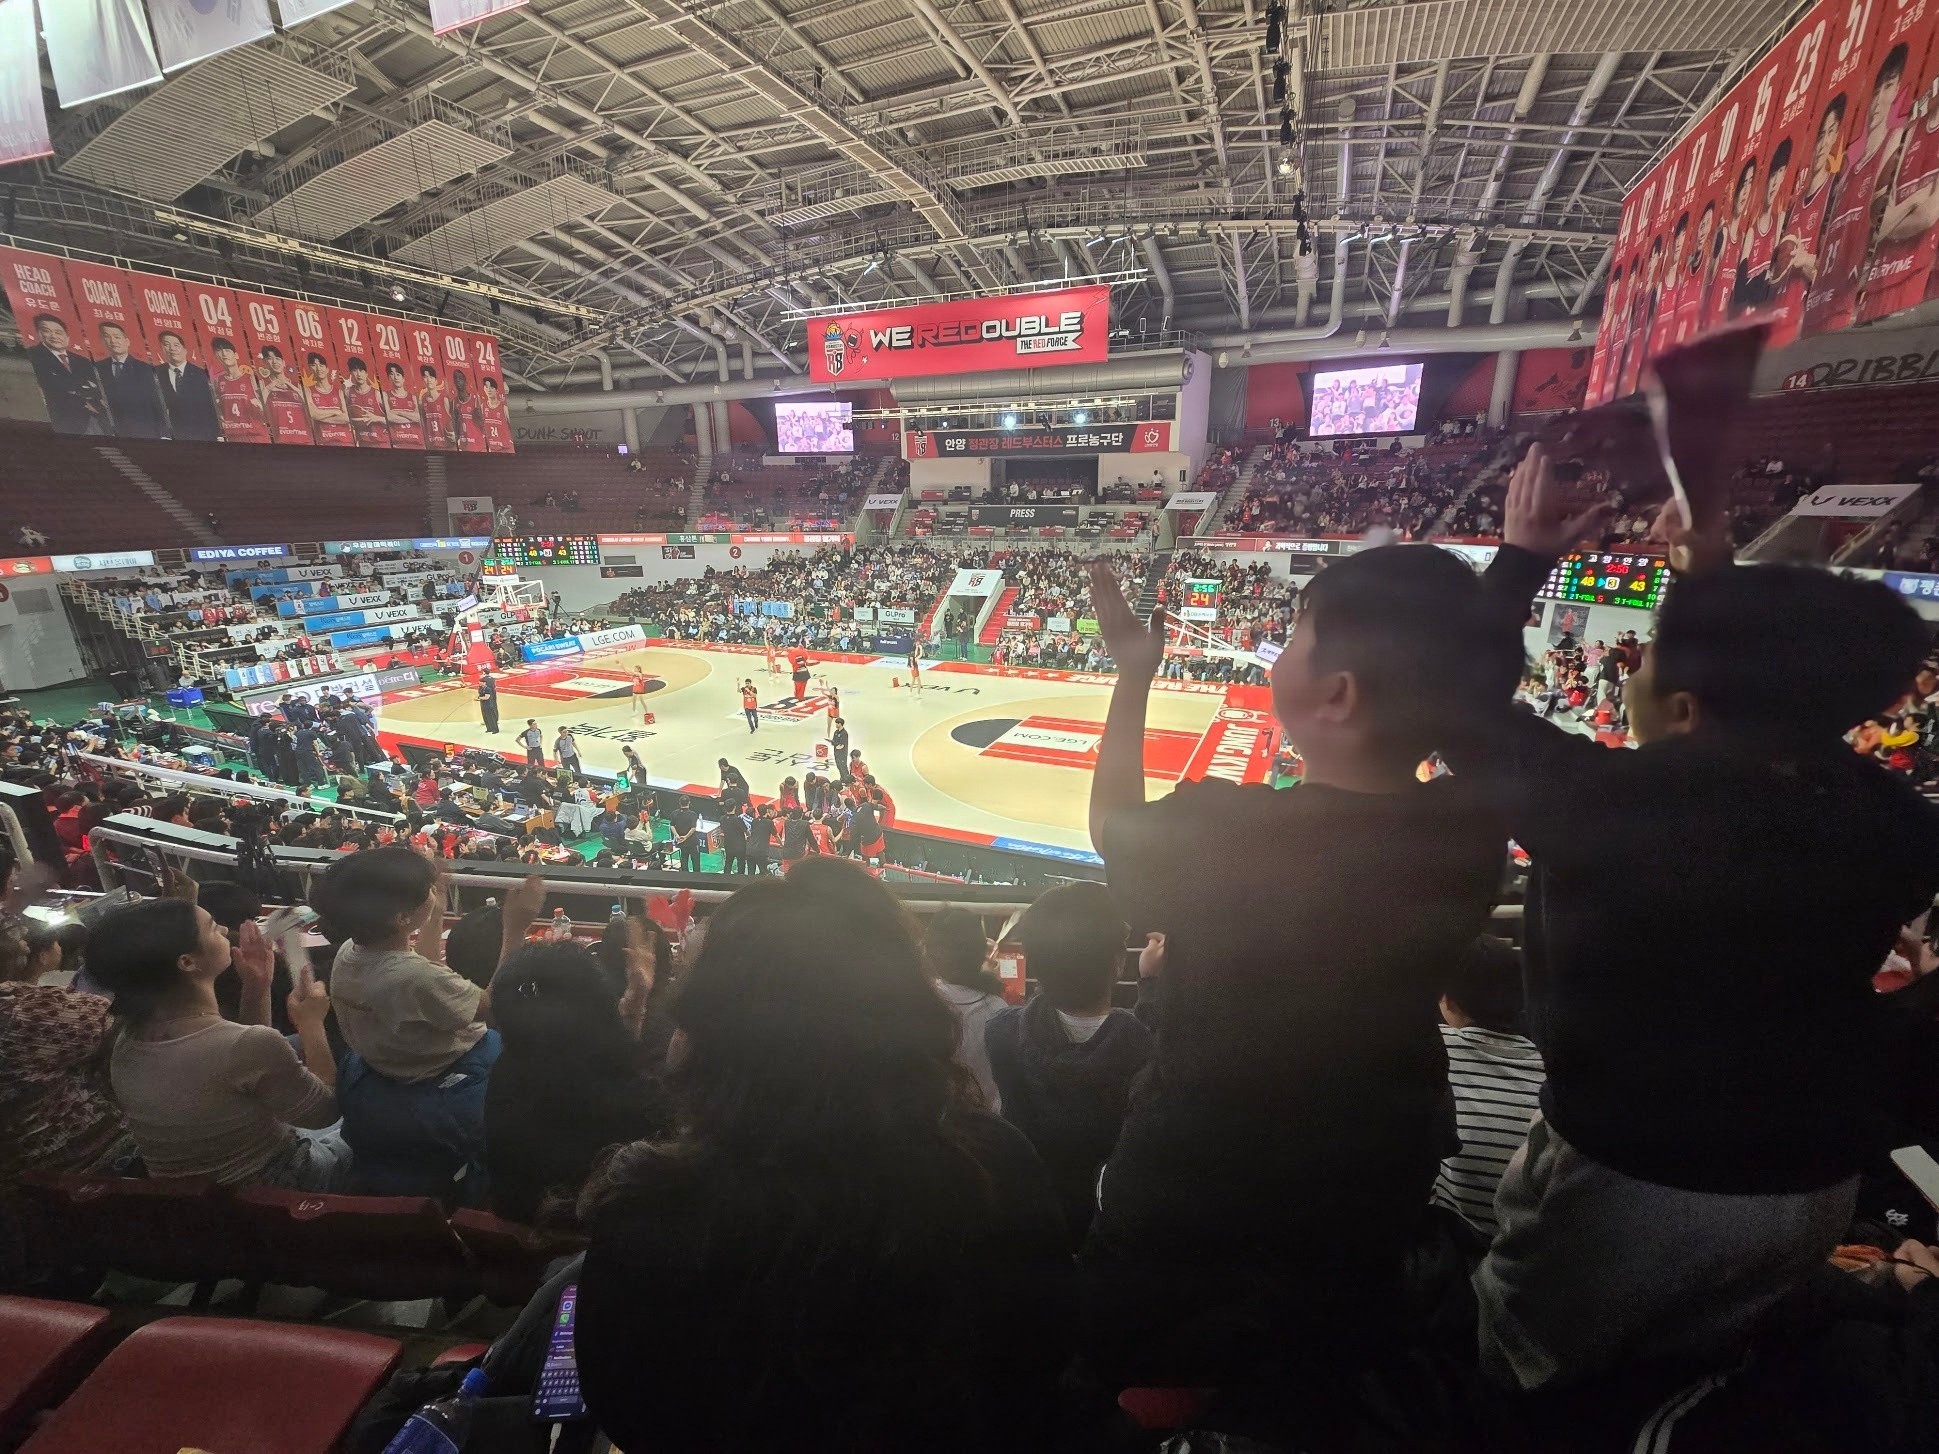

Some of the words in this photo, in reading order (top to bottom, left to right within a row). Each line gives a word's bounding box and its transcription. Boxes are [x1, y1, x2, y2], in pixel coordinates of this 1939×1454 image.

[1783, 19, 1826, 109] 23
[1748, 64, 1778, 139] 15
[1713, 102, 1739, 168] 10
[13, 264, 51, 284] HEAD
[20, 280, 56, 297] COACH
[82, 278, 122, 307] COACH
[144, 289, 181, 316] COACH
[199, 294, 232, 327] 04
[249, 302, 280, 334] 05
[295, 309, 323, 339] 06
[339, 317, 362, 346] 12
[376, 324, 400, 351] 20
[870, 325, 912, 349] WE
[413, 330, 433, 356] 13
[445, 336, 466, 361] 00
[1020, 337, 1032, 350] THE
[1032, 336, 1046, 349] RED
[1046, 335, 1068, 348] FORCE
[476, 341, 495, 365] 24
[1789, 374, 1807, 389] 14
[231, 403, 240, 416] 4
[286, 411, 294, 423] 5
[1269, 418, 1280, 428] 13
[891, 432, 899, 441] 12
[945, 438, 966, 451] 안양
[968, 437, 999, 451] 정관장
[1001, 434, 1064, 450] 레드부스터스
[1065, 432, 1124, 448] 프로농구단
[1838, 496, 1898, 507] VEXX
[1009, 508, 1035, 518] PRESS
[679, 535, 698, 544] 홍삼톤
[197, 549, 236, 560] EDIYA
[238, 547, 282, 557] COFFEE
[732, 548, 739, 557] 2
[309, 568, 332, 577] VEXX
[484, 566, 494, 574] 24
[500, 565, 512, 574] 24
[1581, 576, 1595, 587] 48
[1629, 580, 1646, 592] 43
[1193, 584, 1215, 593] 2:56
[360, 595, 382, 604] VEXX
[1190, 592, 1209, 606] 24
[1597, 594, 1604, 603] 5
[386, 609, 408, 618] VEXX
[885, 610, 906, 618] GLPro
[592, 629, 636, 646] LGE.COM
[531, 643, 556, 654] POCARI
[1013, 732, 1088, 745] LGE.COM
